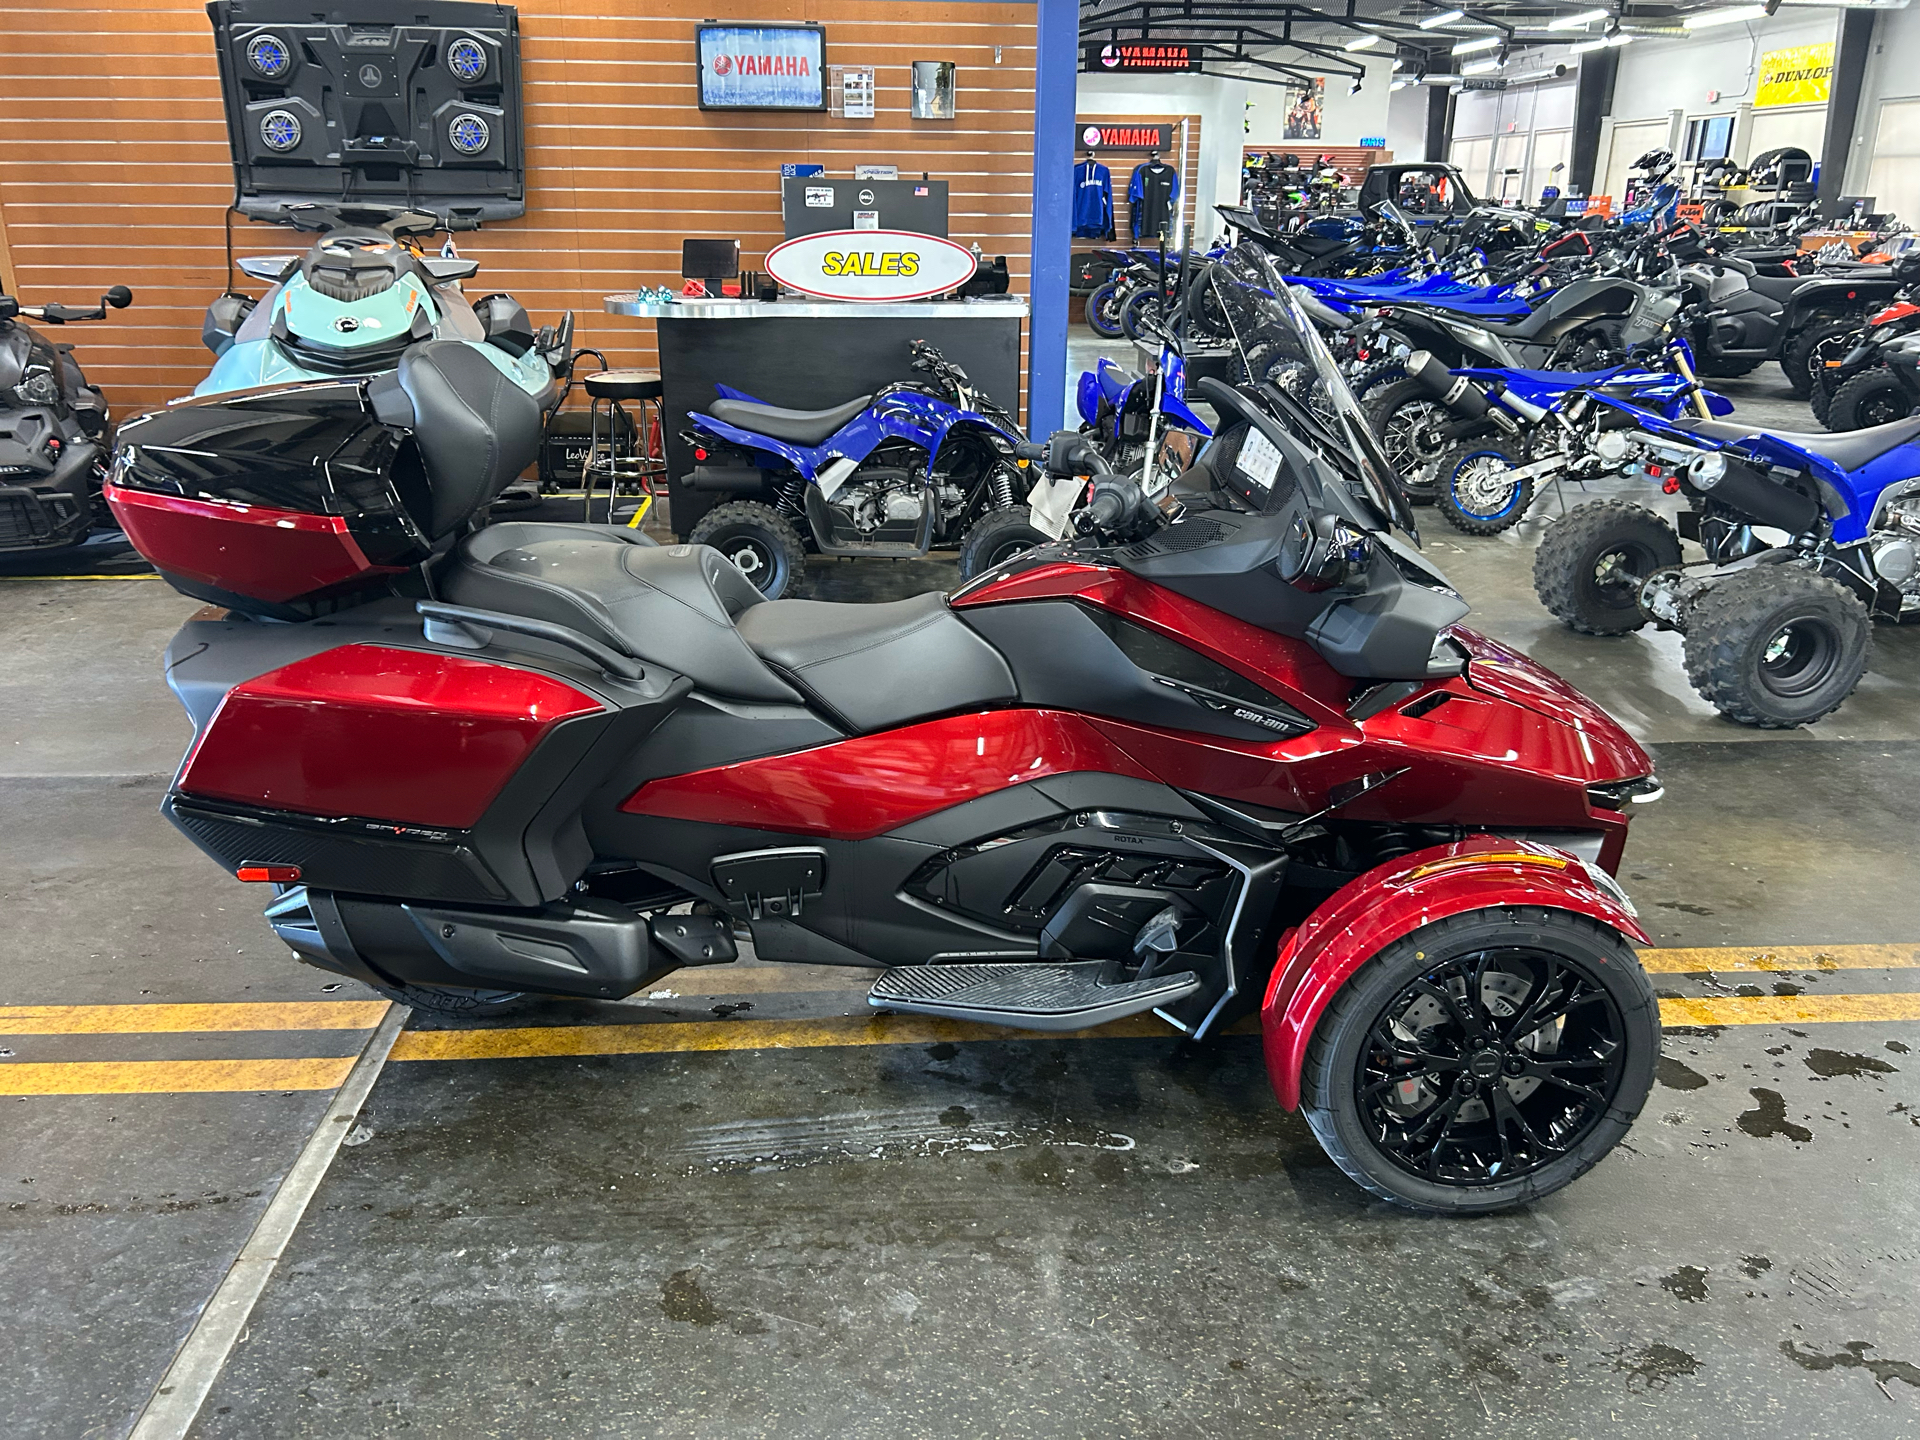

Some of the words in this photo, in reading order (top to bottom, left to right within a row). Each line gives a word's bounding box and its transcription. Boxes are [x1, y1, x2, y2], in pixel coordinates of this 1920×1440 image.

[1121, 46, 1190, 67] YAMAHA
[734, 54, 810, 77] YAMAHA
[1101, 128, 1160, 146] YAMAHA
[1361, 138, 1384, 147] PARTS
[1680, 208, 1701, 216] KTM
[822, 252, 920, 276] SALES
[1451, 325, 1469, 336] YAMAHA
[565, 447, 606, 460] LeoVice
[1114, 835, 1144, 845] ROTAX
